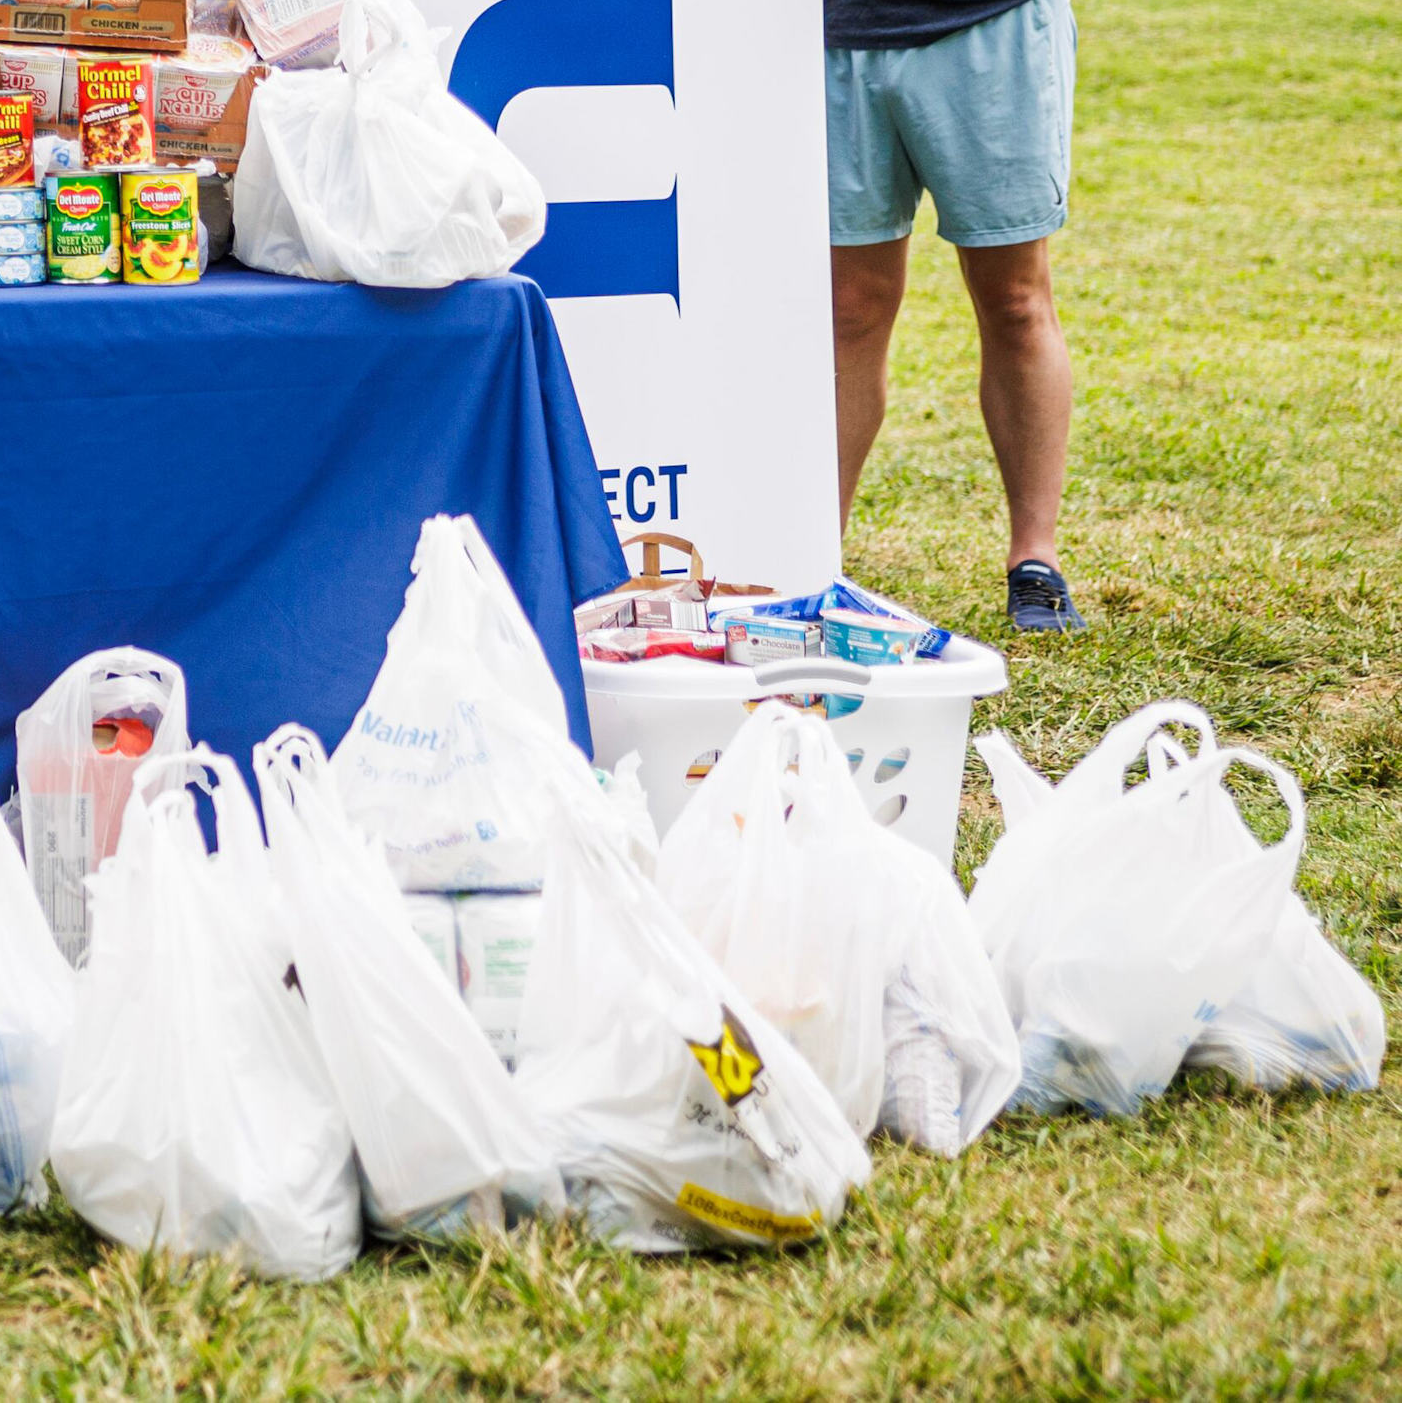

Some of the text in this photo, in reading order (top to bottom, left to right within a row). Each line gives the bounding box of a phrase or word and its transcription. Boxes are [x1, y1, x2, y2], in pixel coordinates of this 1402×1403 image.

[91, 18, 140, 30] CHICKEN
[80, 65, 141, 82] Hormel
[87, 82, 131, 99] Chili
[175, 87, 215, 105] CUP
[159, 101, 224, 120] NOODLES
[1, 135, 20, 147] Beans
[159, 140, 208, 152] CHICKEN
[59, 195, 100, 205] Del Monte
[141, 192, 181, 202] Del Monte
[131, 221, 191, 230] Freestone Slices
[57, 234, 104, 245] SWEET CORN
[57, 245, 104, 254] CREAM STYLE
[761, 638, 801, 651] Chocolate
